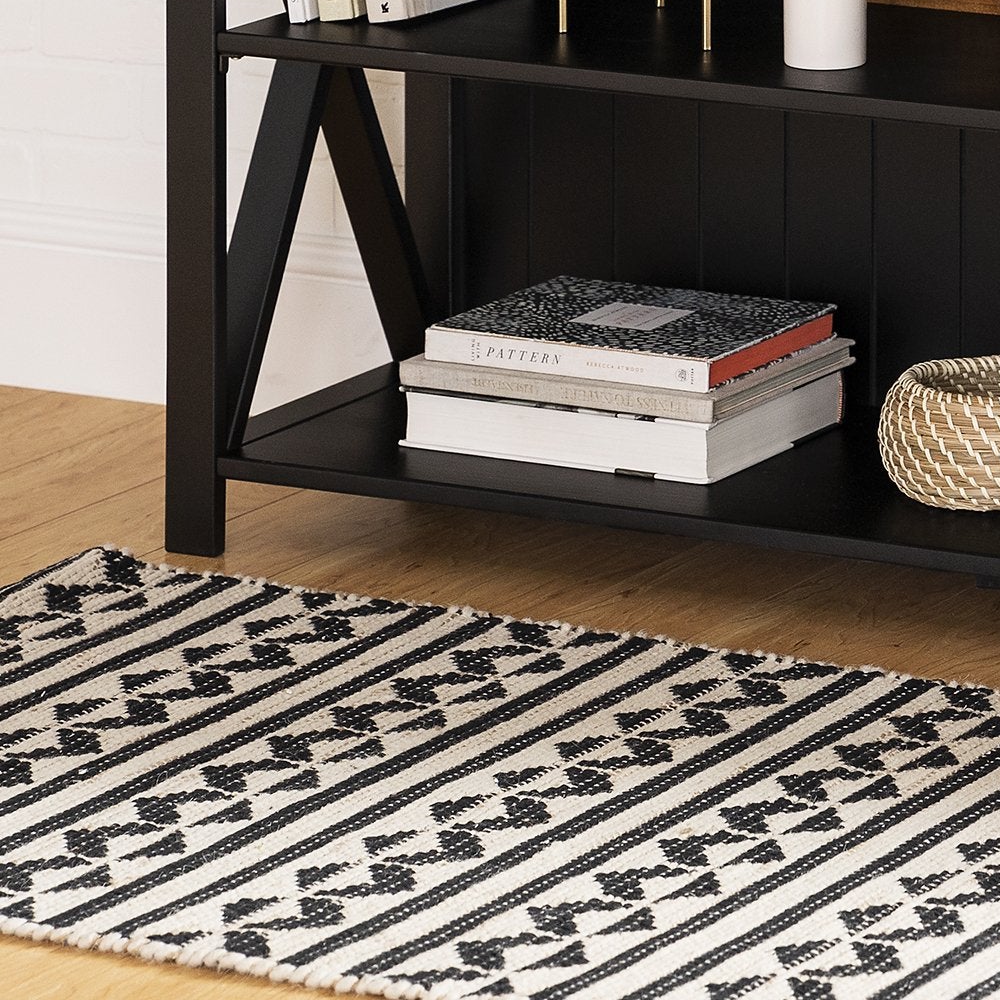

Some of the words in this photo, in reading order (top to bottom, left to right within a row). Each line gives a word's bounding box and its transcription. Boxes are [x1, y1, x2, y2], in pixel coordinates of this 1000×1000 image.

[486, 346, 561, 365] PATTERN
[586, 361, 614, 369] REBECCA
[617, 365, 644, 373] ATWOOD
